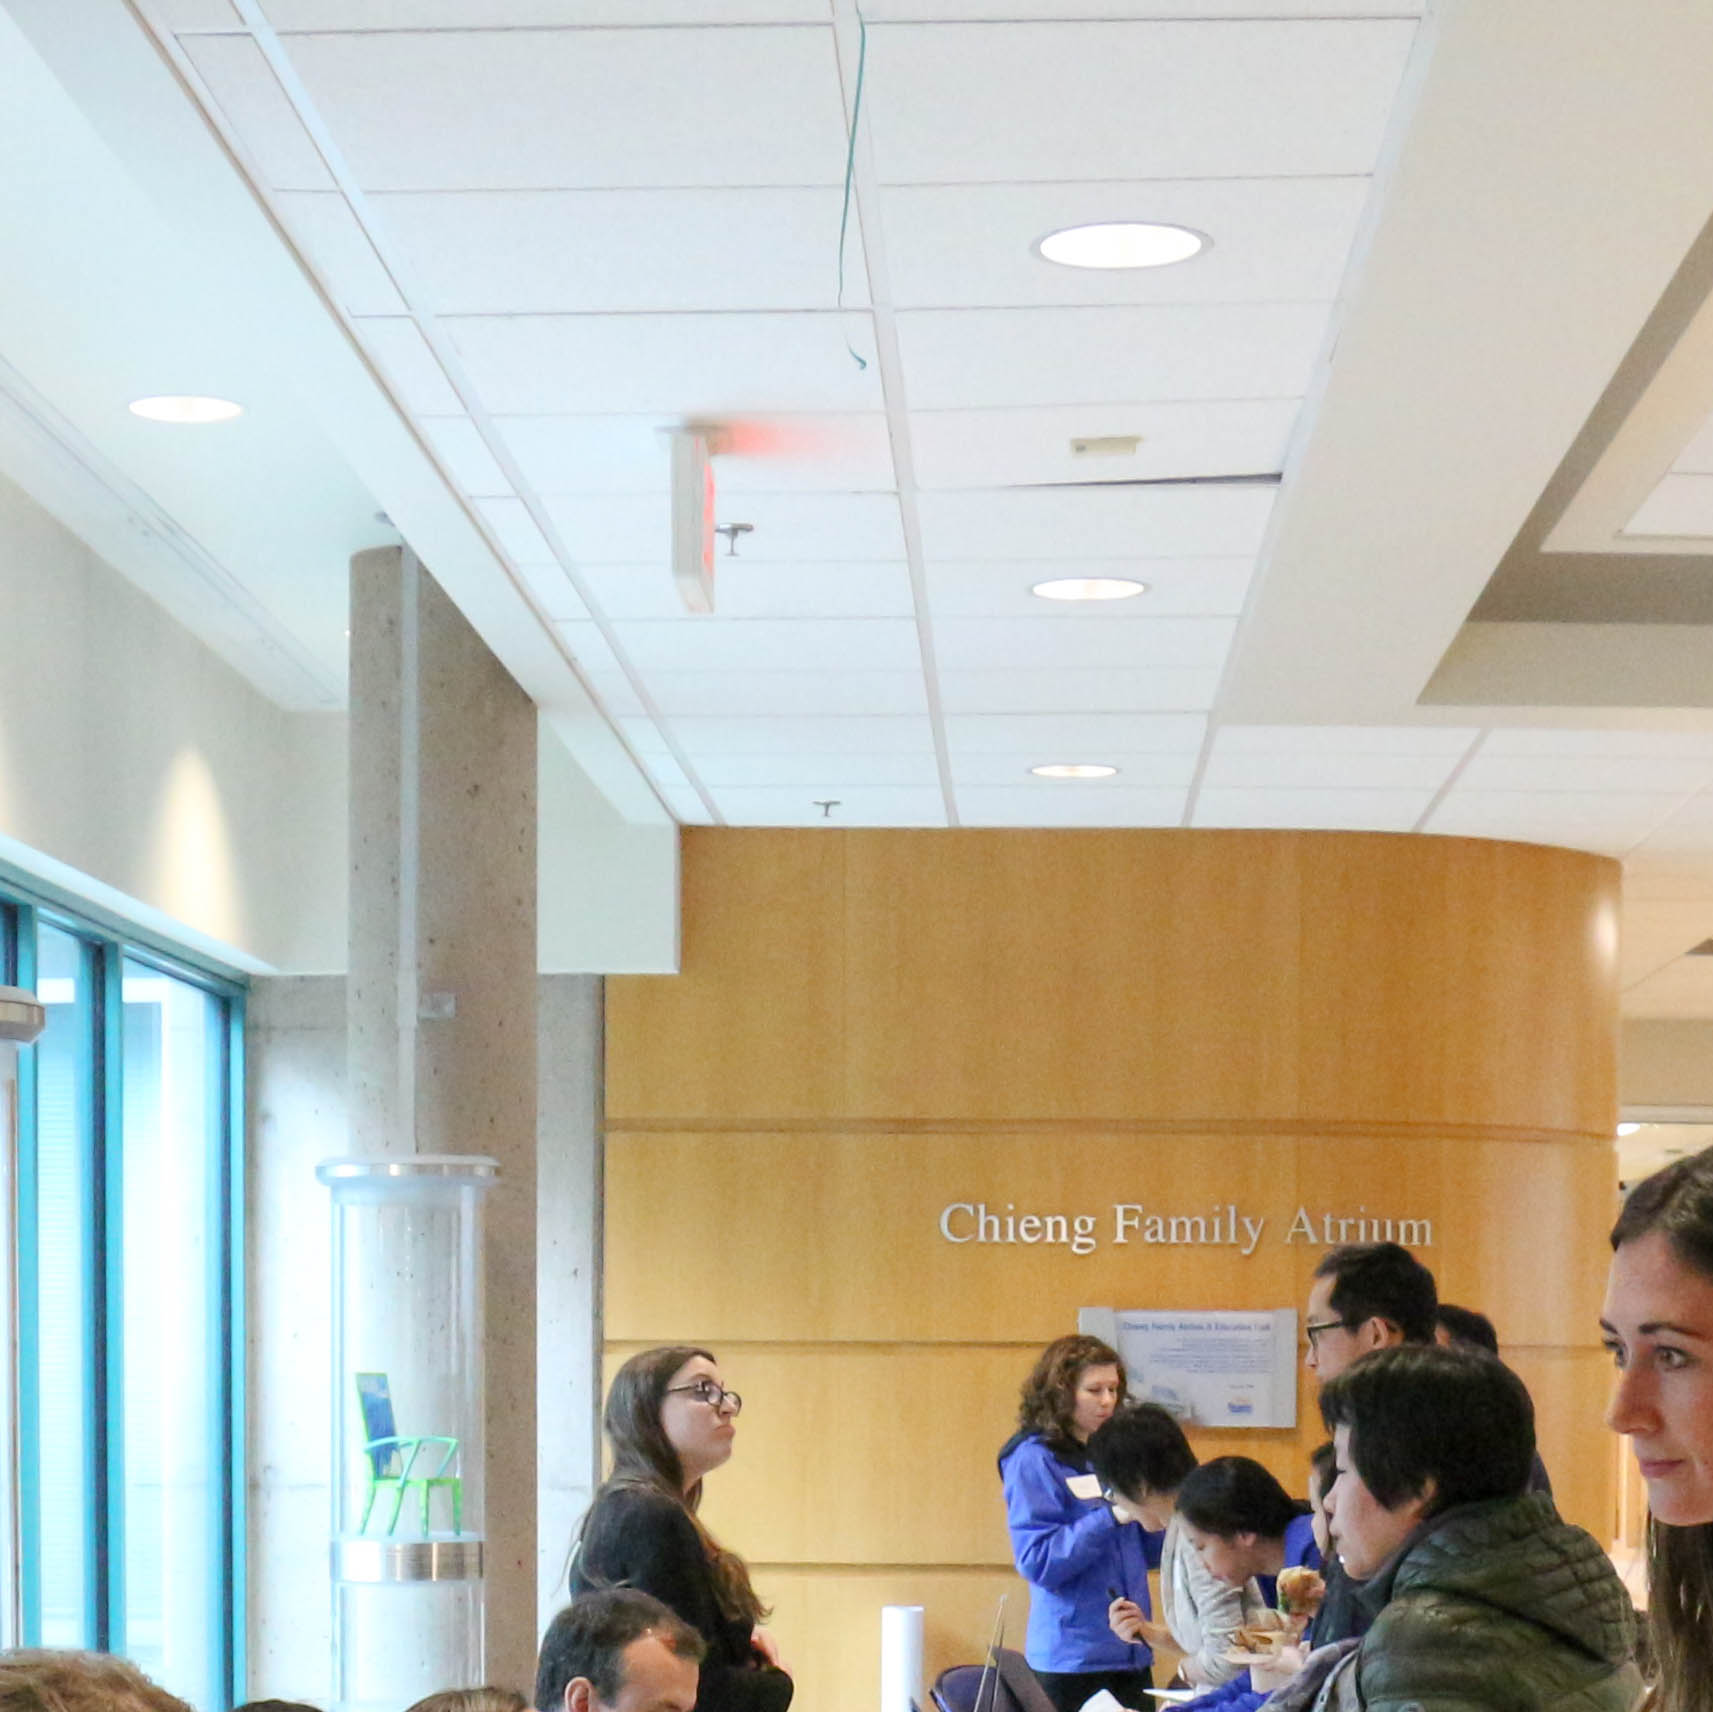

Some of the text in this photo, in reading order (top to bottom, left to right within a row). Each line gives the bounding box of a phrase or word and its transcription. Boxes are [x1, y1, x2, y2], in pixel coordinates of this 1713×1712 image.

[938, 1203, 1433, 1255] Chieng Family Atrium
